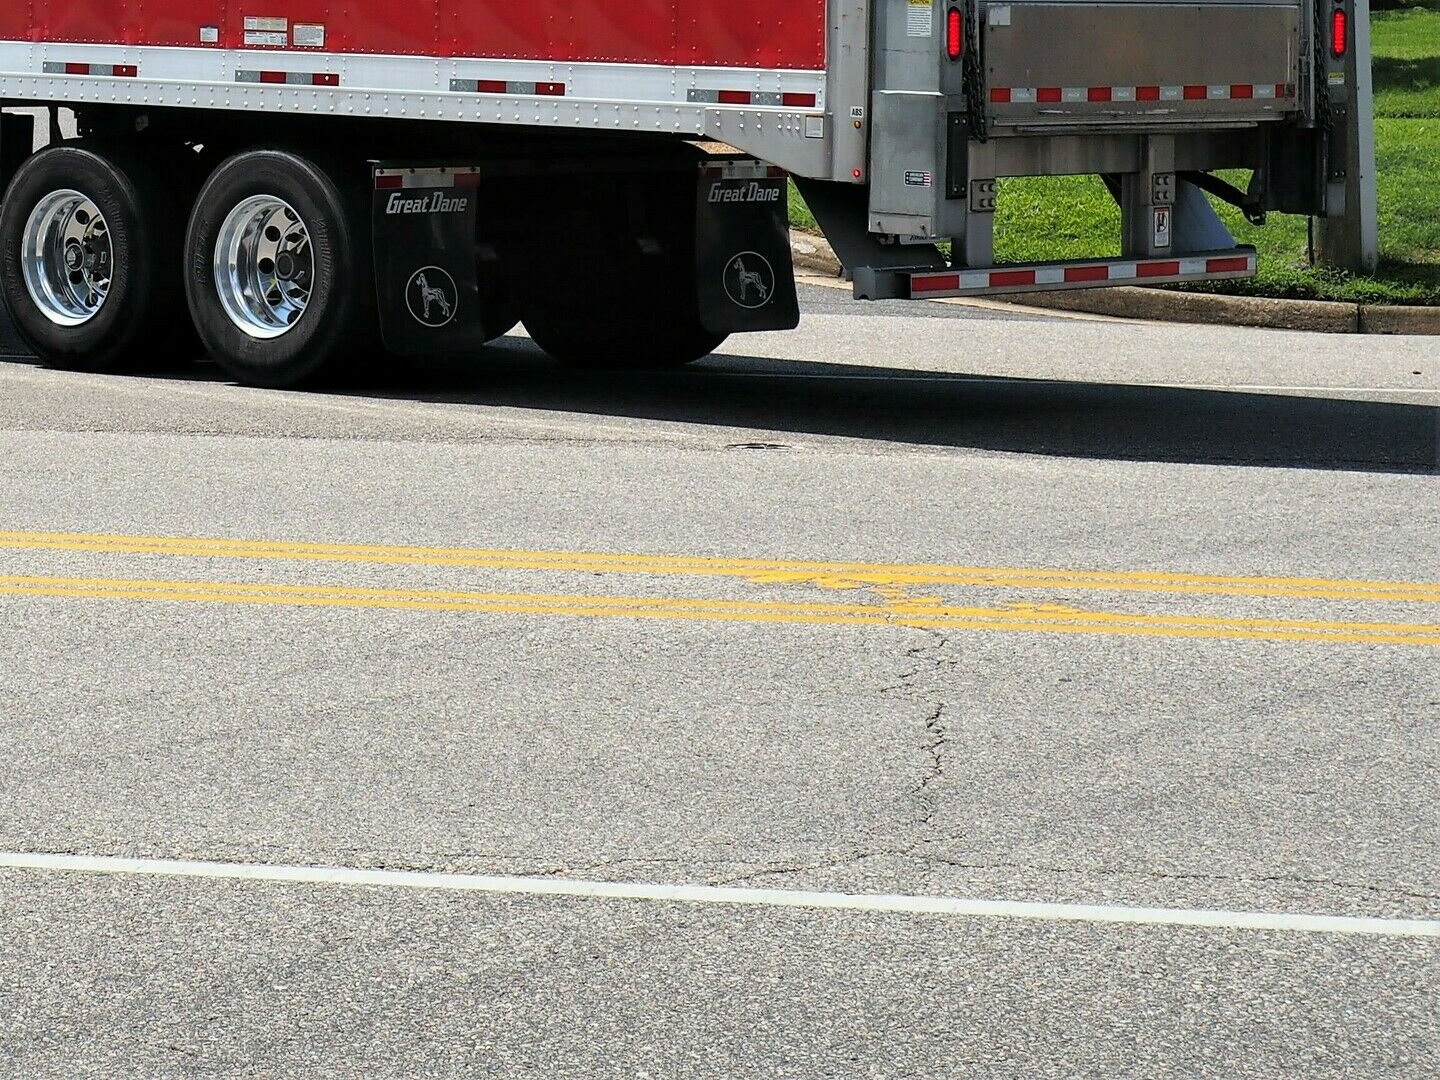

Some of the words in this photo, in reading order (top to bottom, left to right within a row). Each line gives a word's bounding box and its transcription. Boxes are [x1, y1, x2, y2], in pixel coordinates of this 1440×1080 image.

[851, 108, 863, 116] ABS
[386, 192, 430, 215] Great
[429, 191, 468, 213] Dane
[707, 182, 746, 203] Great
[746, 181, 780, 201] Dane
